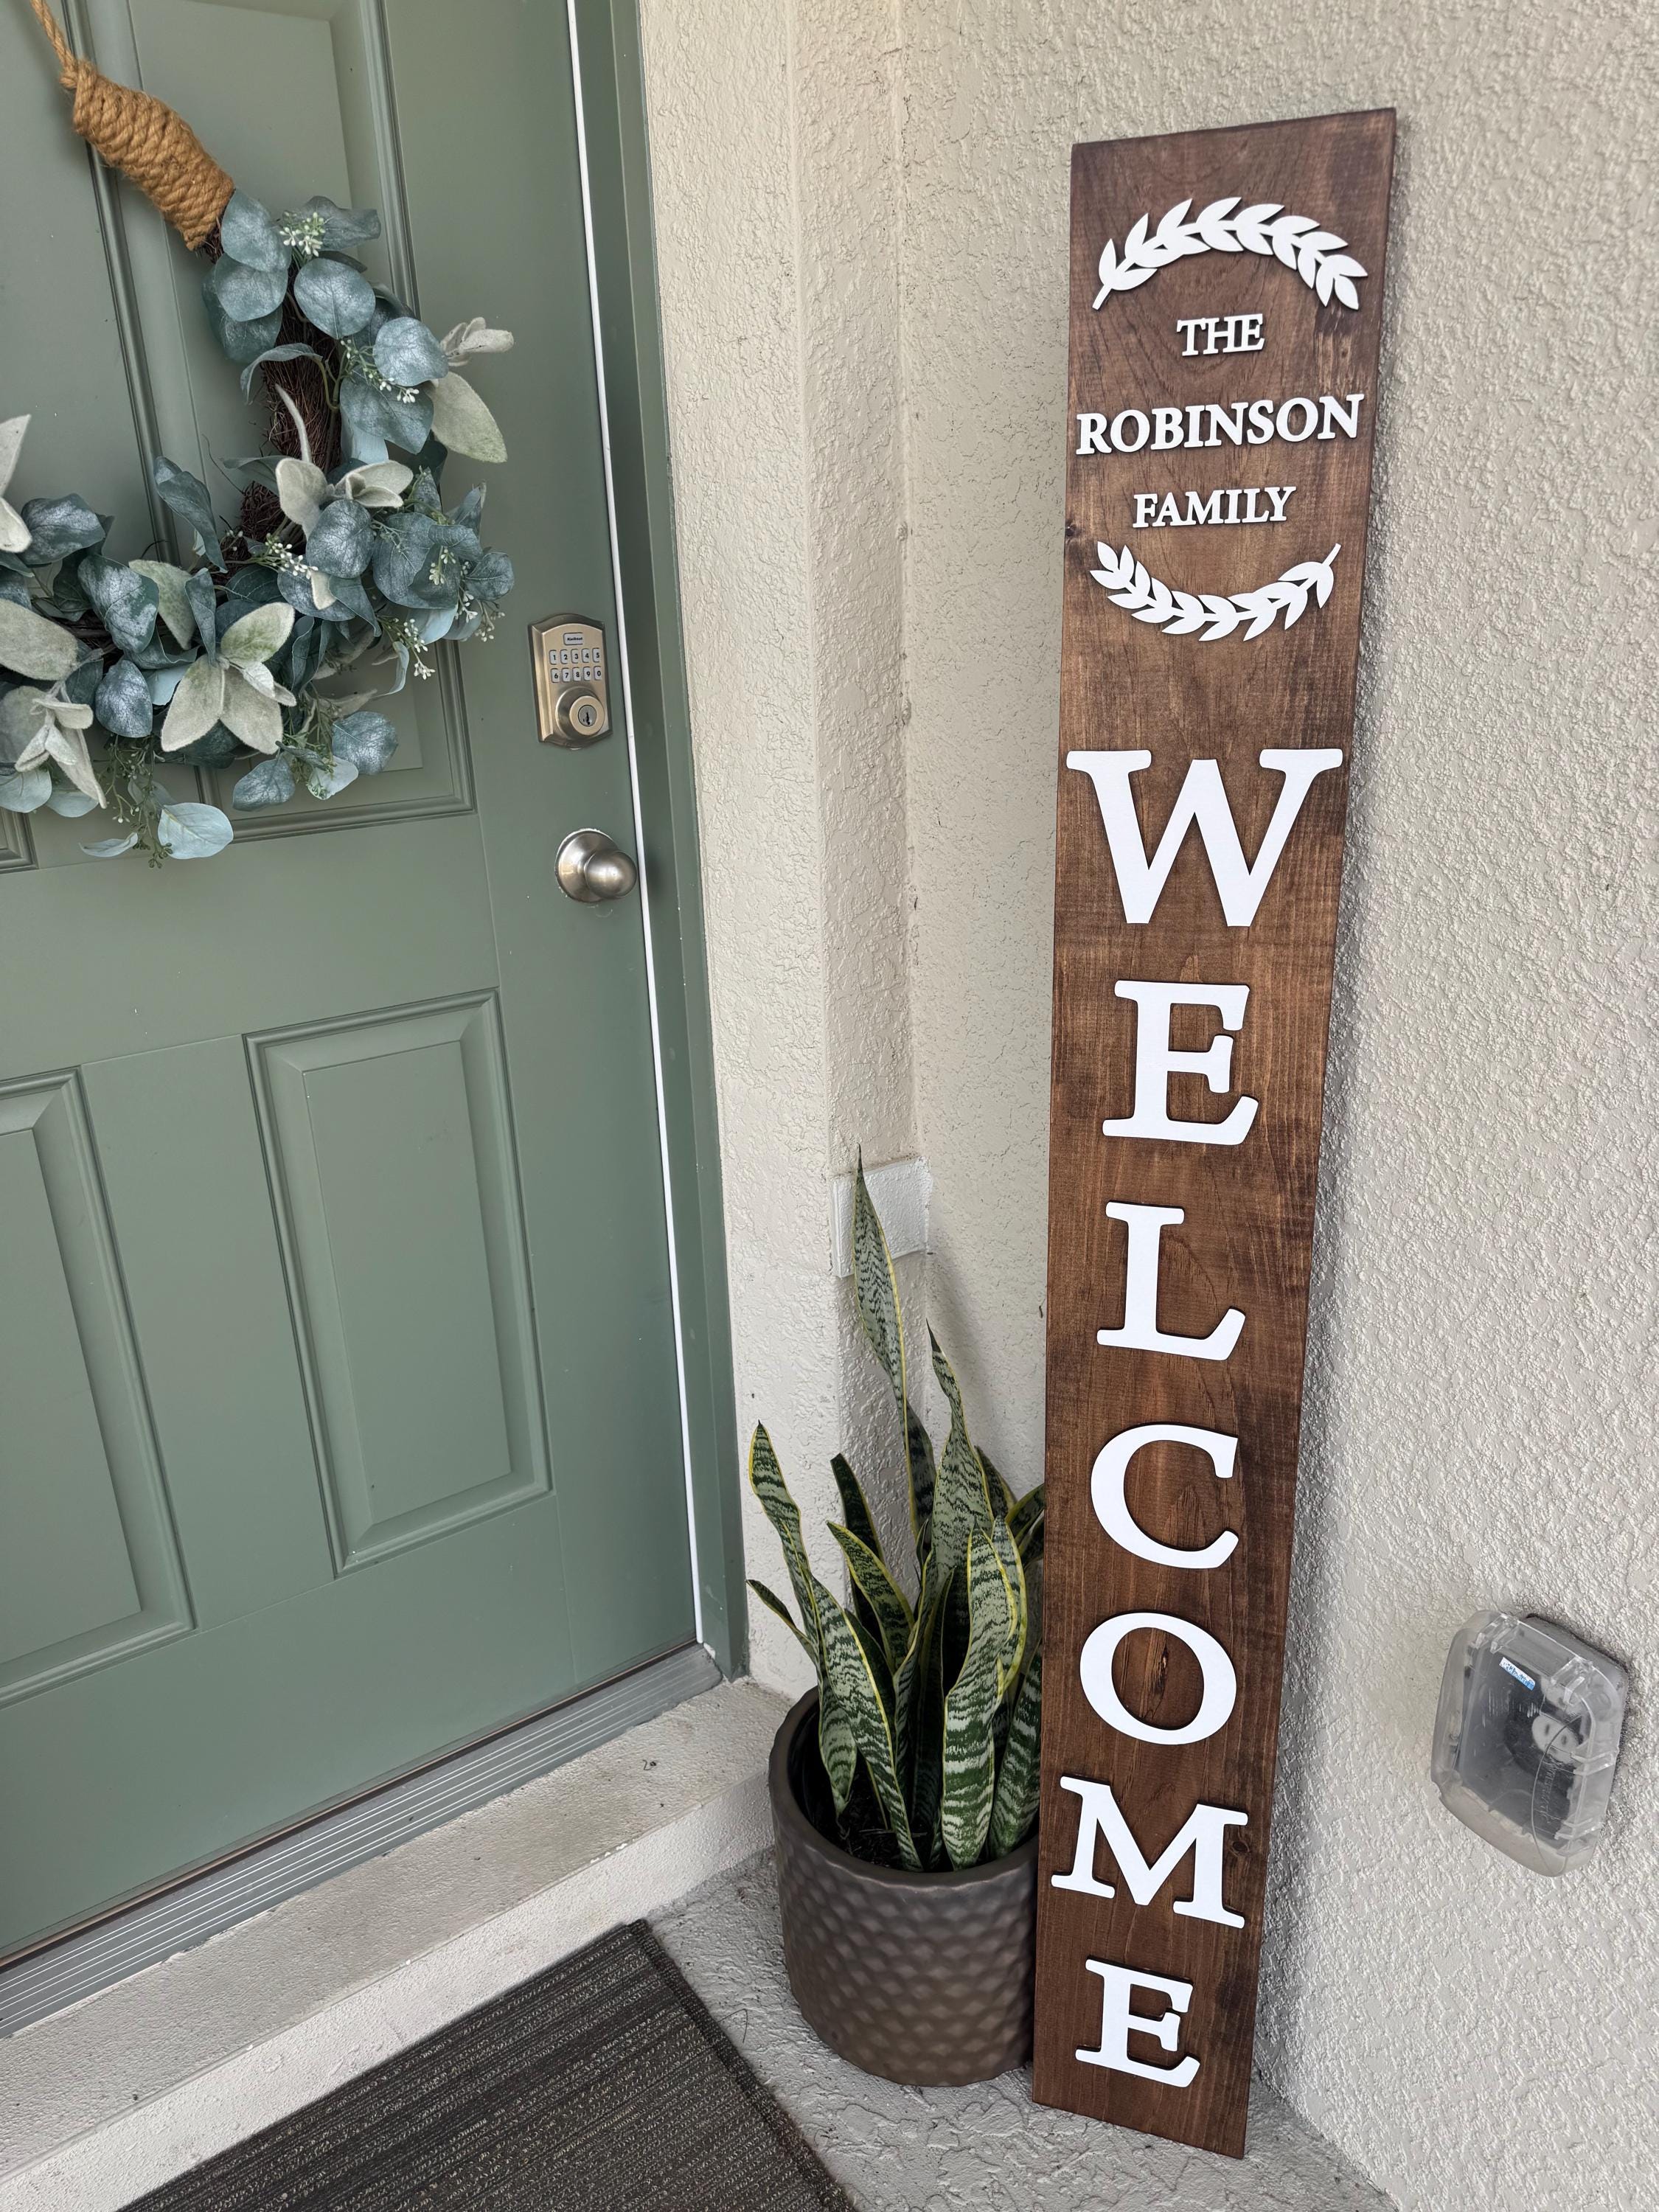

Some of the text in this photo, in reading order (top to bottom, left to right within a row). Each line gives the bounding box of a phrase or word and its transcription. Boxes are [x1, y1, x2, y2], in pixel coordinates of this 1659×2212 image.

[1175, 313, 1265, 356] THE
[1076, 393, 1365, 455] ROBINSON
[1132, 486, 1297, 528] FAMILY
[1051, 748, 1343, 2087] WELCOME
